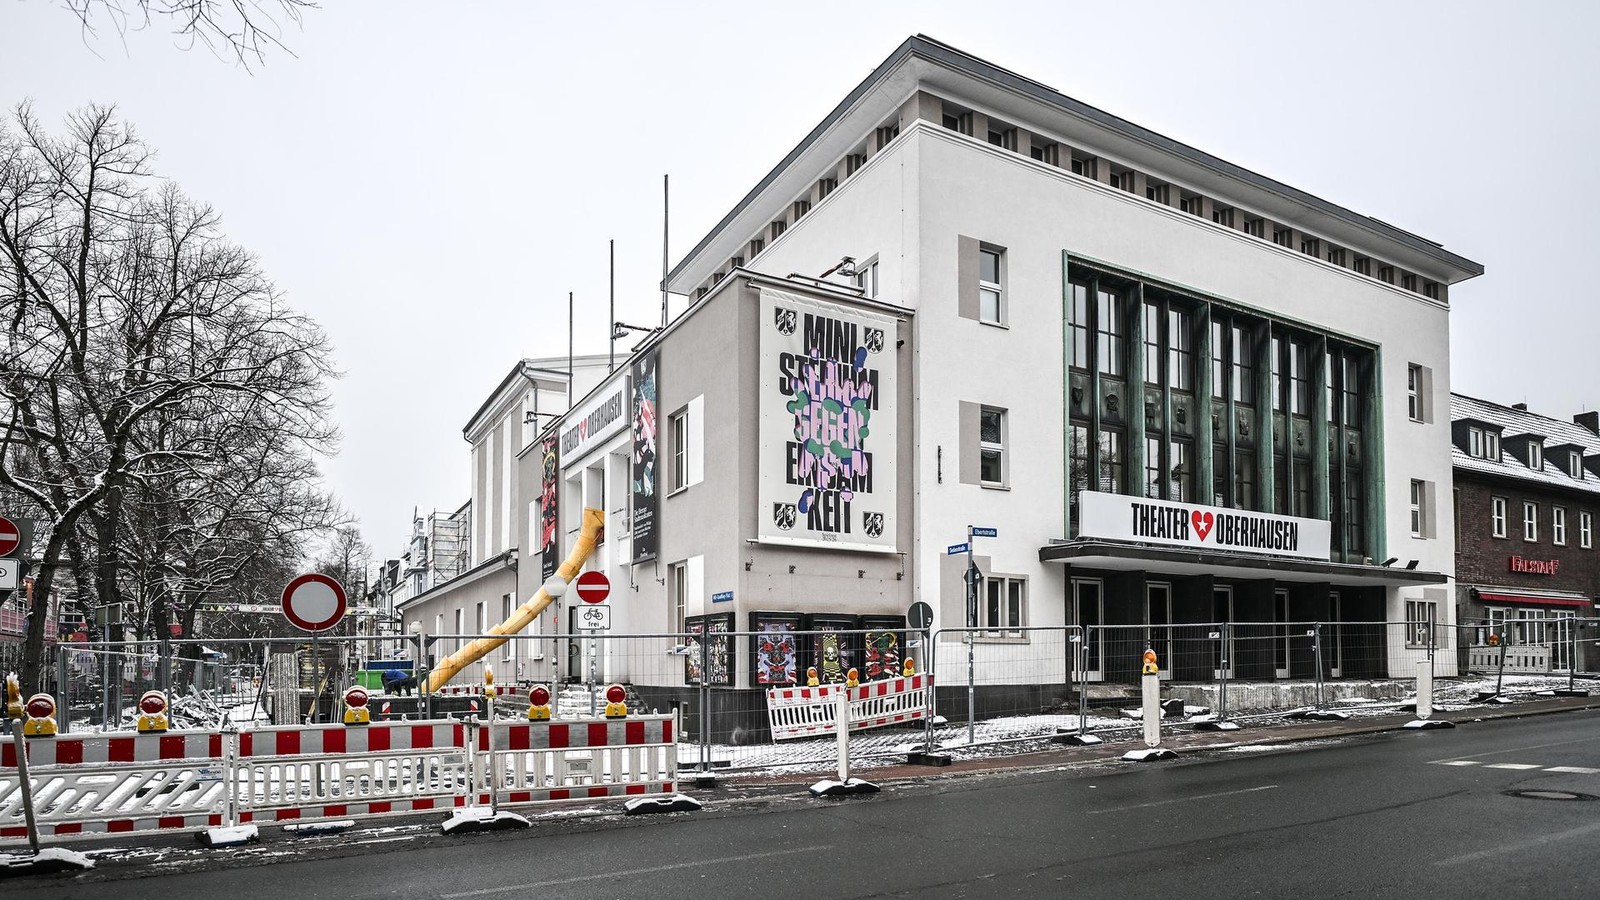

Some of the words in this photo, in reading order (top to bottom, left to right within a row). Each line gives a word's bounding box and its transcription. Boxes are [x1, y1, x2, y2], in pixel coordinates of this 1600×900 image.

[803, 313, 857, 364] MINI
[561, 424, 580, 457] THEATER
[587, 390, 623, 438] OBERHAUSEN
[807, 488, 852, 533] KEIT
[1131, 503, 1190, 540] THEATER
[1216, 514, 1298, 551] OBERHAUSEN
[1511, 556, 1558, 574] FALSTAFF
